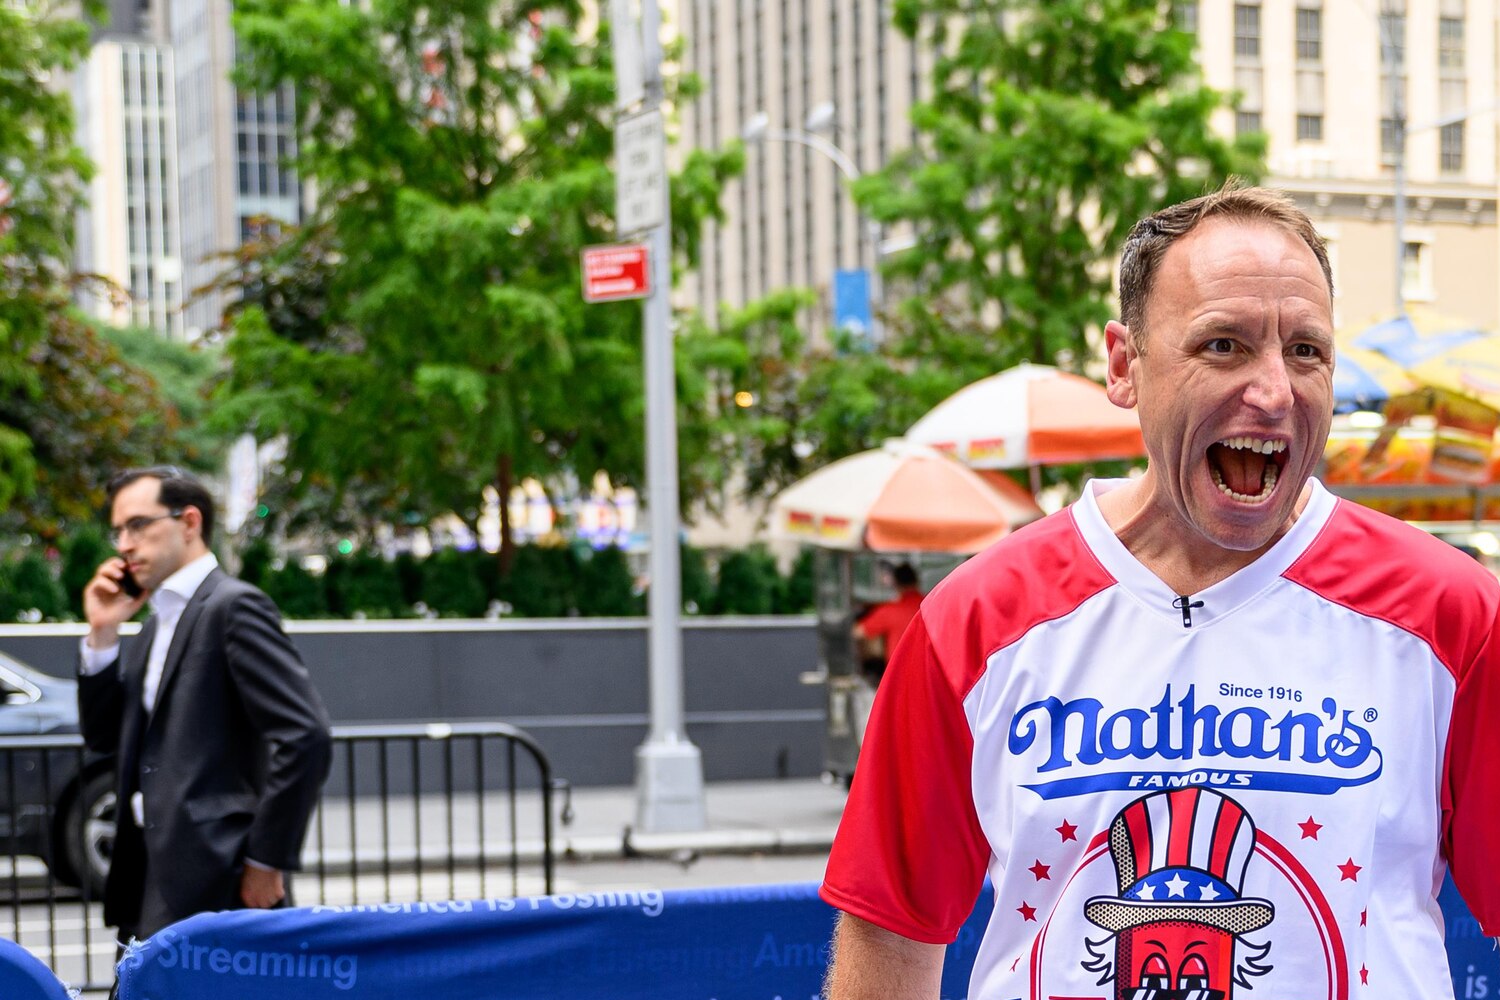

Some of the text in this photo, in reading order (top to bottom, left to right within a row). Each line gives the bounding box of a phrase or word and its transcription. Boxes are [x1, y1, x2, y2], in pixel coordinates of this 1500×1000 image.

[1219, 683, 1303, 703] Since 1916
[1008, 683, 1373, 774] Nathan's
[1128, 770, 1254, 788] FAMOUS
[157, 930, 359, 991] Streaming
[1465, 963, 1489, 999] is
